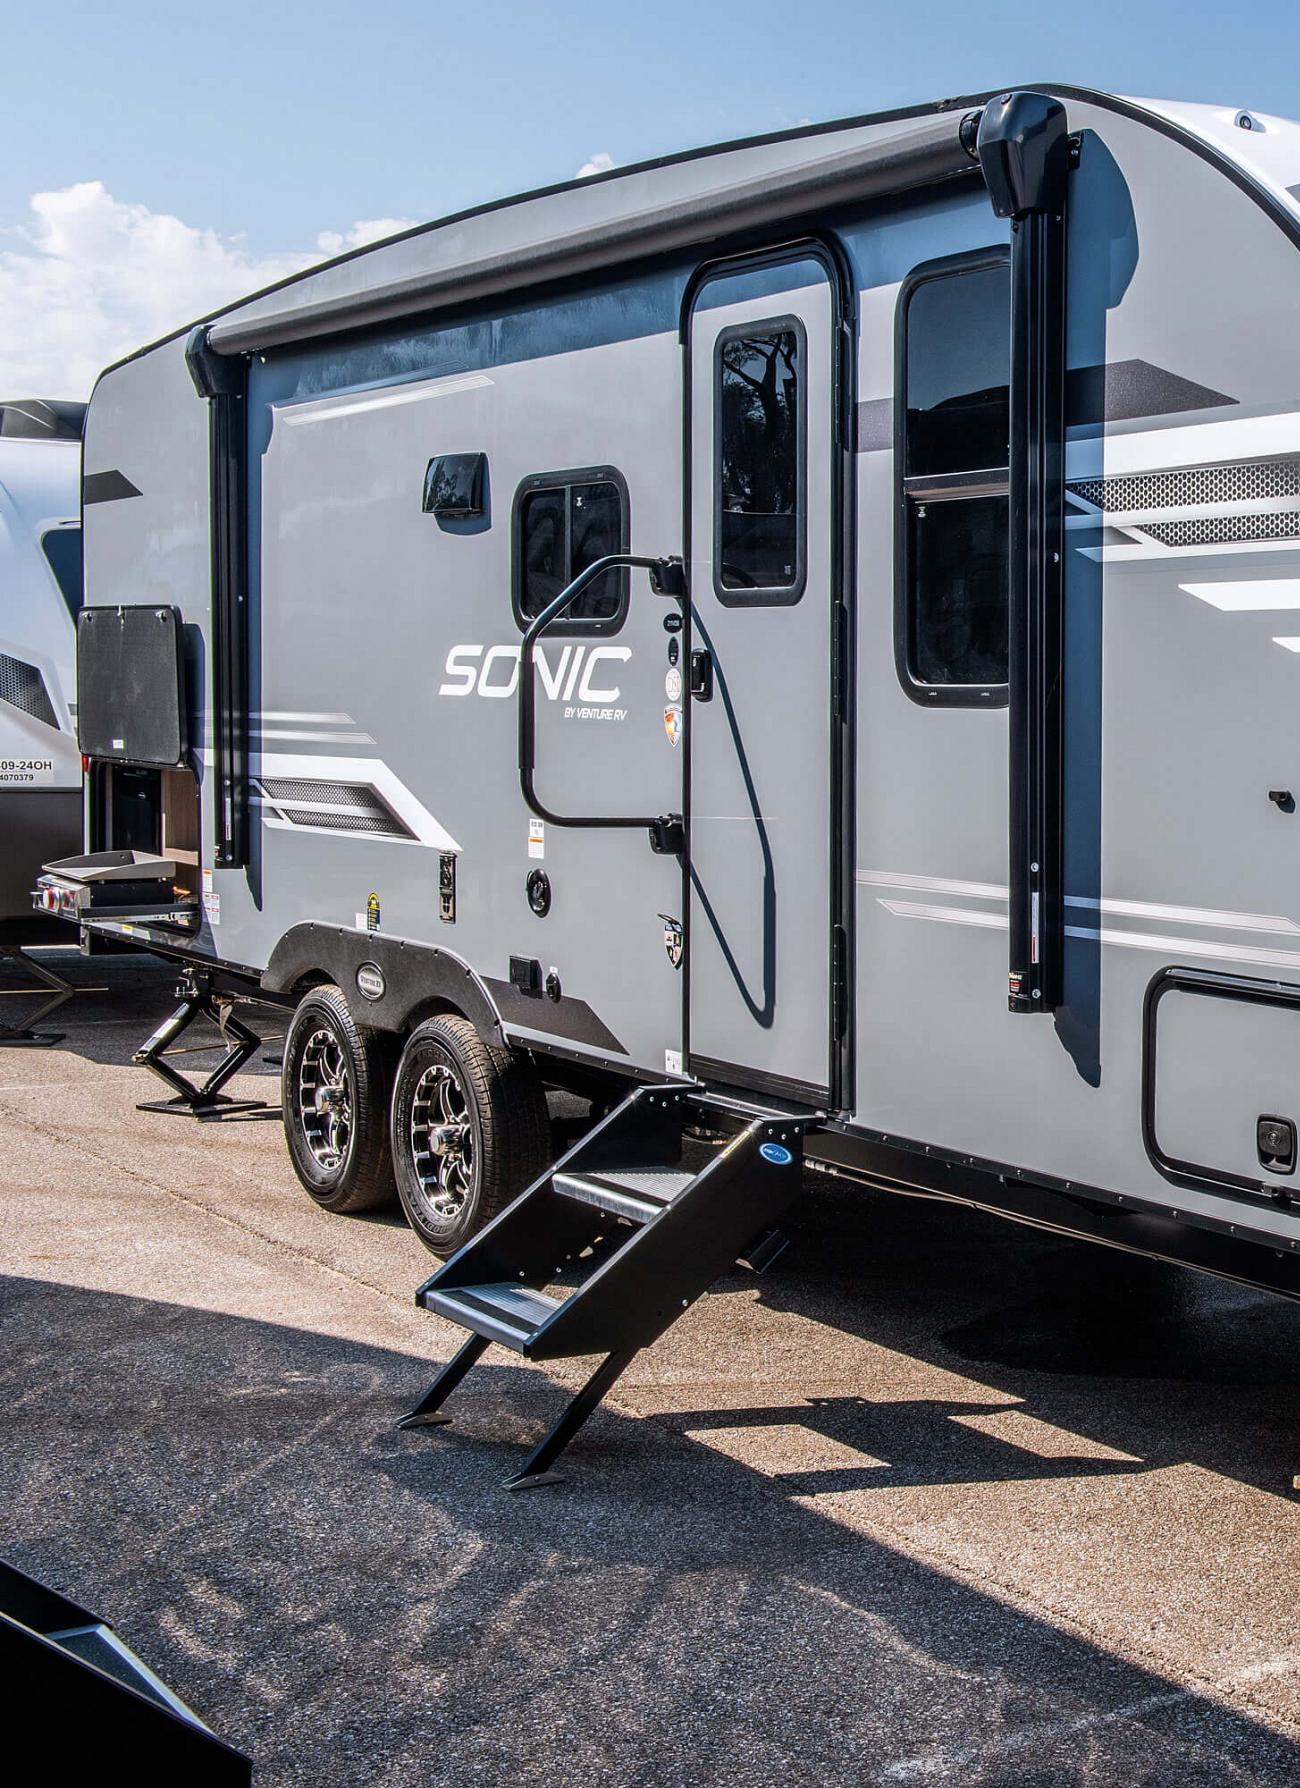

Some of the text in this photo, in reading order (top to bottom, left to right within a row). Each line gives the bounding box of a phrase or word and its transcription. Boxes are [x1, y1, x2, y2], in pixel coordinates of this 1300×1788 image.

[438, 645, 632, 703] SONIC
[564, 707, 628, 721] BY VENTURE RV
